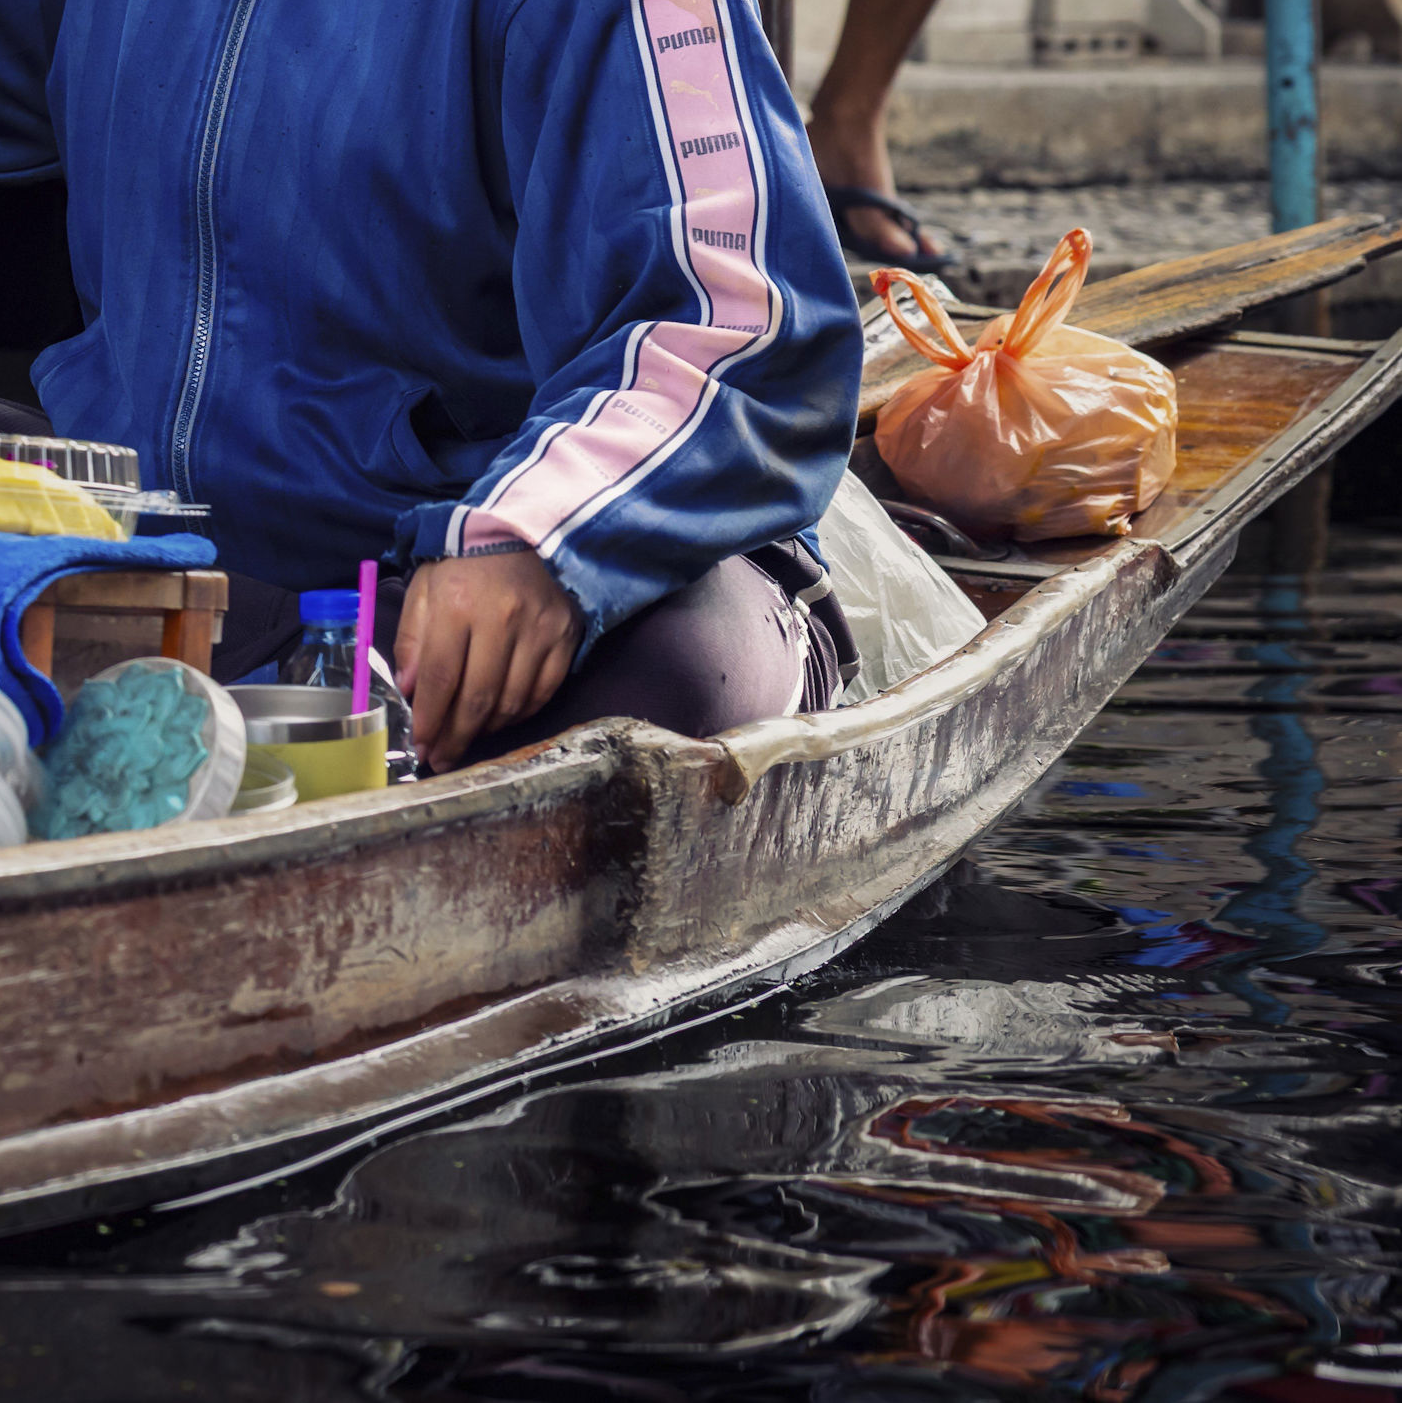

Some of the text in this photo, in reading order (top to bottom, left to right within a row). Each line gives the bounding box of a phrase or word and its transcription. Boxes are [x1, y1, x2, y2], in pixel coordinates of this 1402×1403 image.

[656, 26, 717, 54] PUMA
[679, 131, 741, 159] PUMA
[692, 227, 746, 251] PUMA
